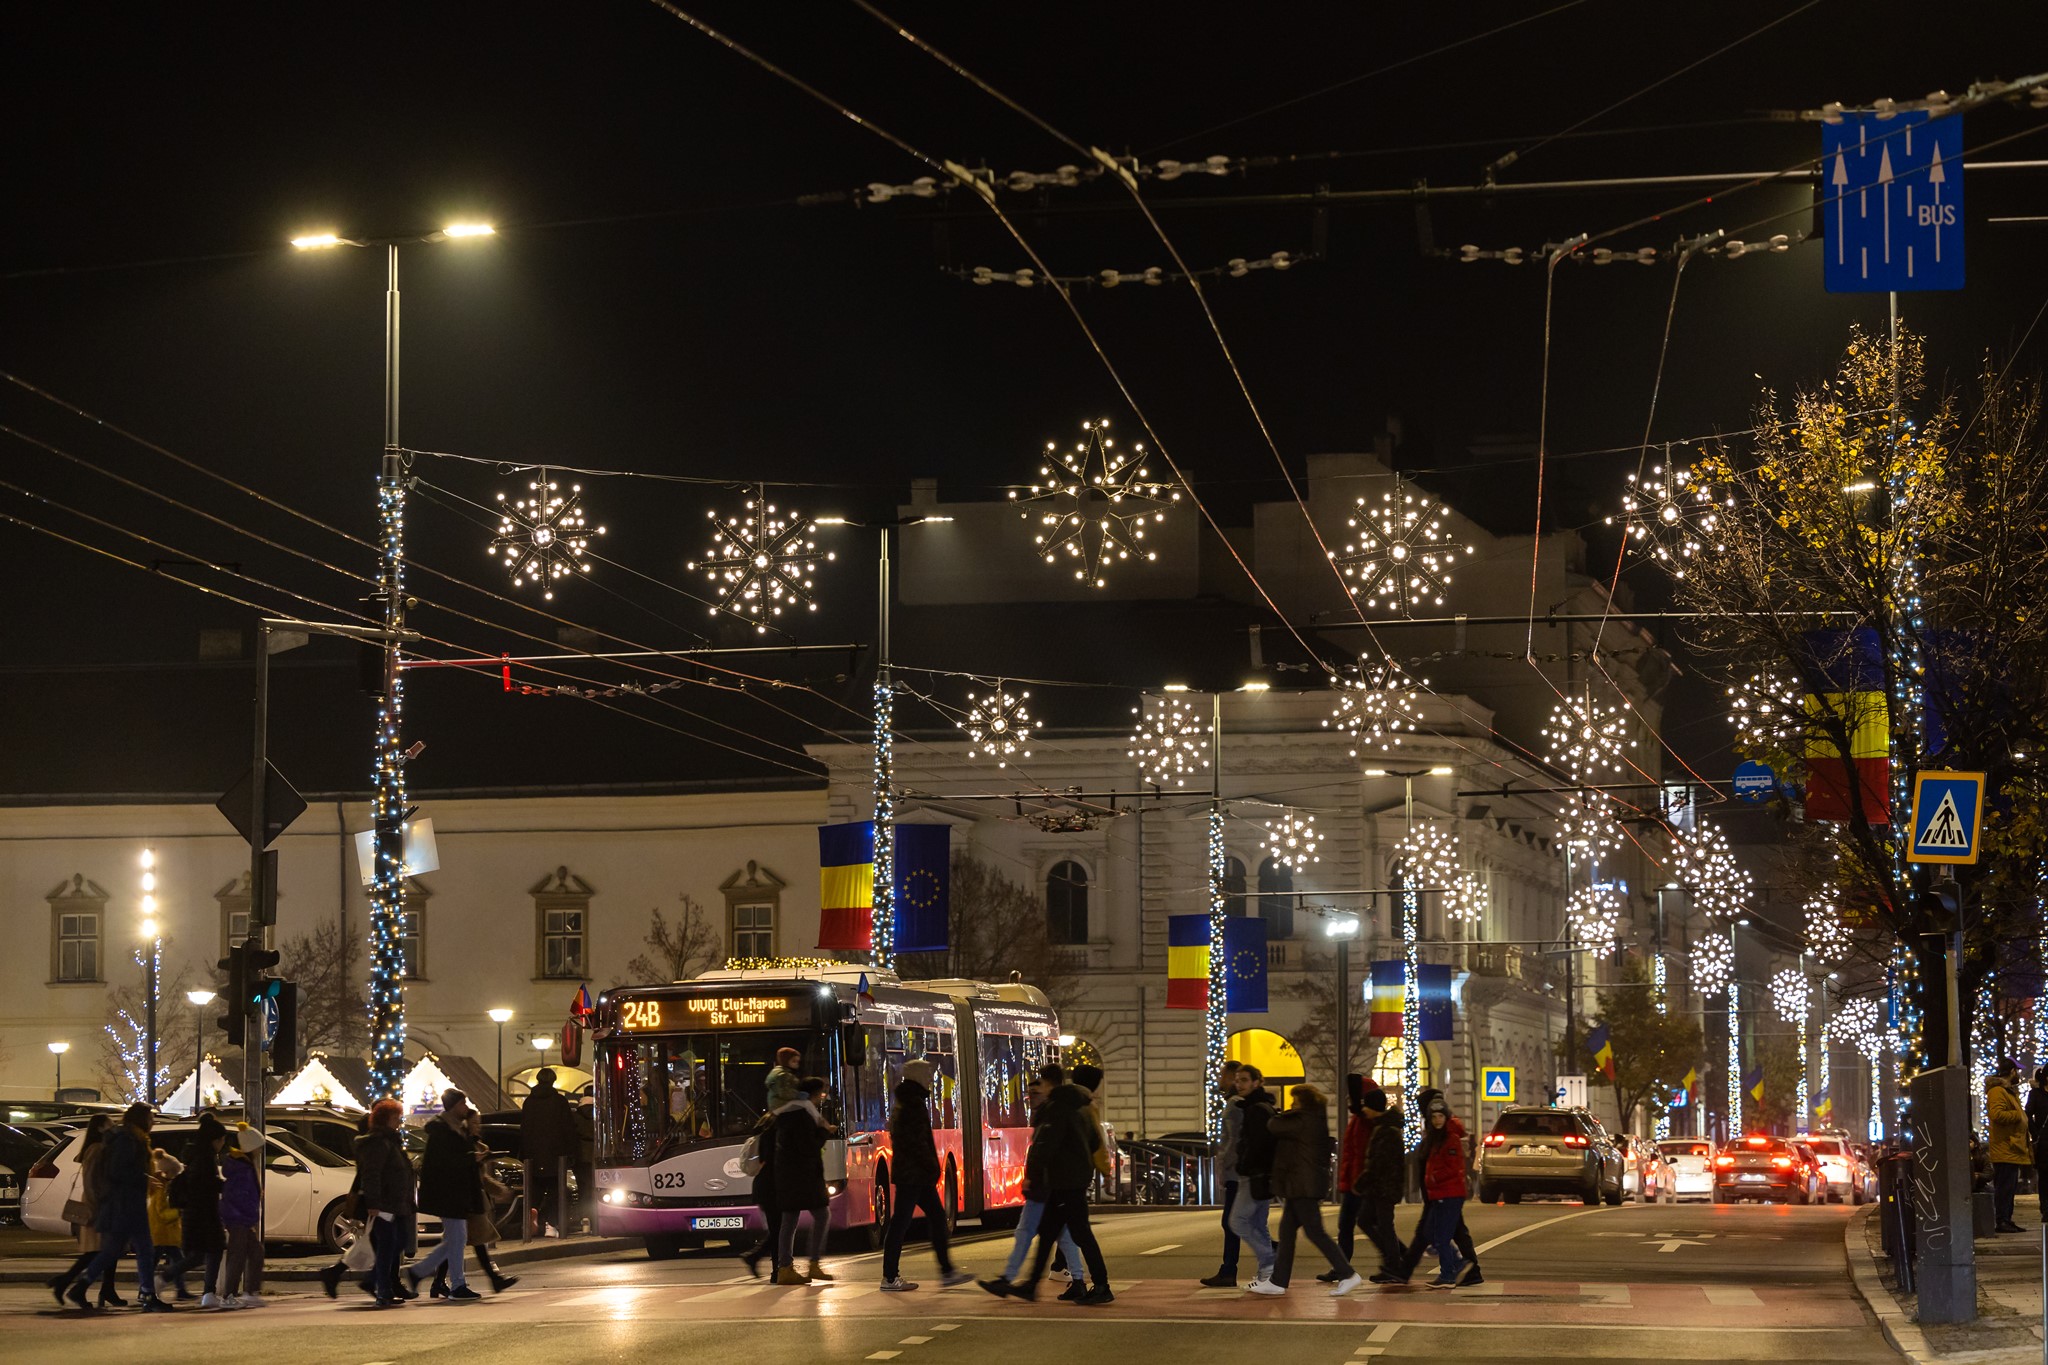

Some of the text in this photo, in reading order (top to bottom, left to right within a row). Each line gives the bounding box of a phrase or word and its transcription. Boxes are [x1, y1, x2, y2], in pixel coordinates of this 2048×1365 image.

[1918, 205, 1956, 226] BUS
[688, 997, 787, 1012] VIVO! Cluj-Napoca
[623, 1001, 661, 1028] 24B
[711, 1010, 765, 1025] Str. Unirii
[654, 1172, 686, 1189] 823
[698, 1219, 710, 1228] CJ
[724, 1217, 741, 1227] JCS
